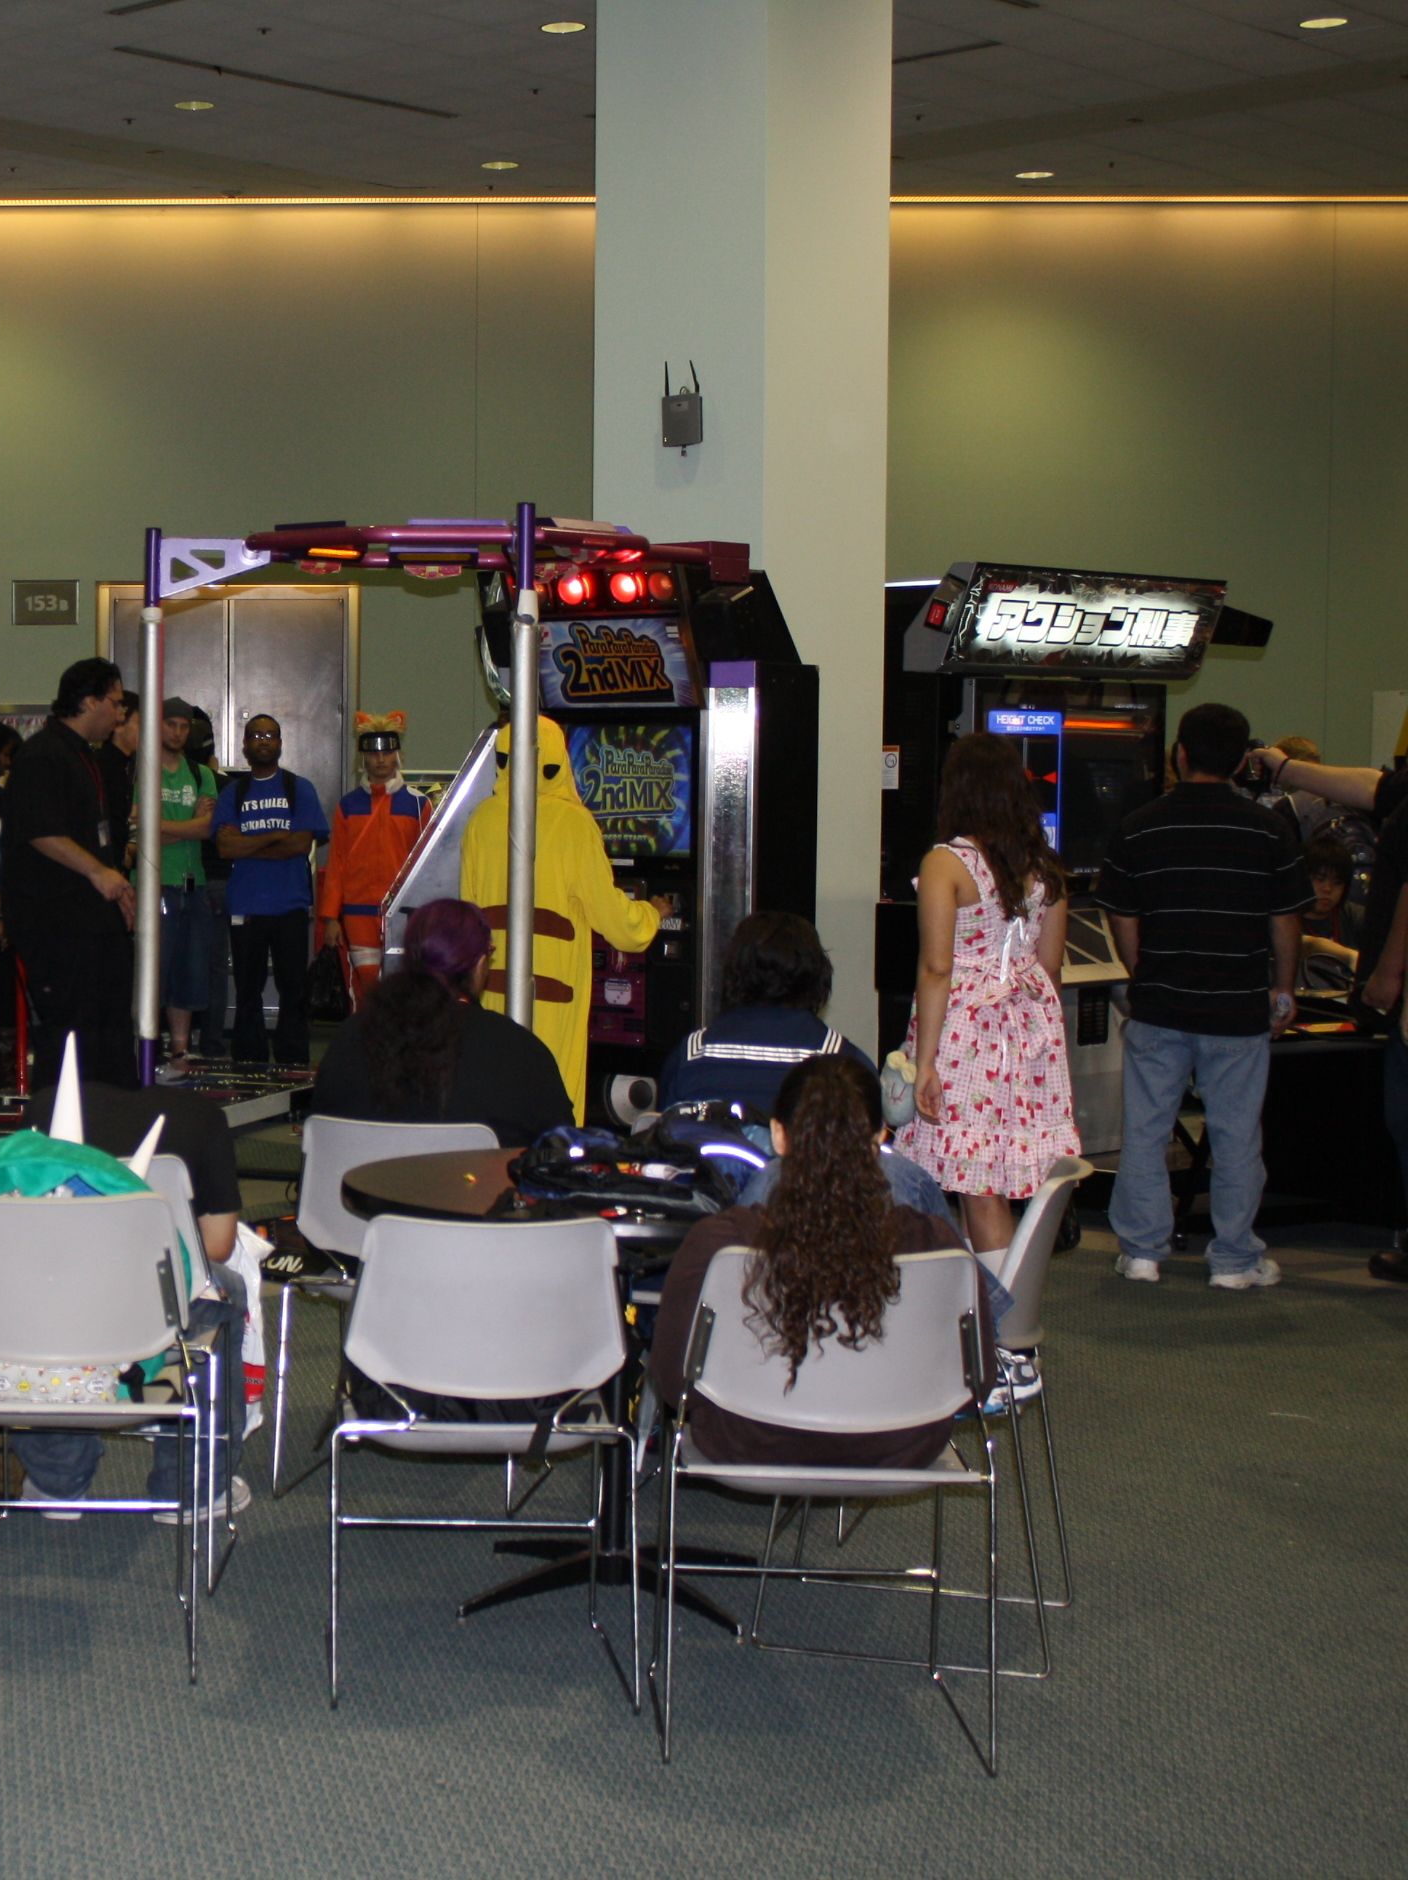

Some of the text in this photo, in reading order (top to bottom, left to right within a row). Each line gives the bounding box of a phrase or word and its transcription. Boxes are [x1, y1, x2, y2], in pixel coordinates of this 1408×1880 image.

[986, 599, 1201, 649] アクション刑事
[996, 715, 1055, 725] HEIGHT CHECK
[266, 817, 291, 831] STYLE
